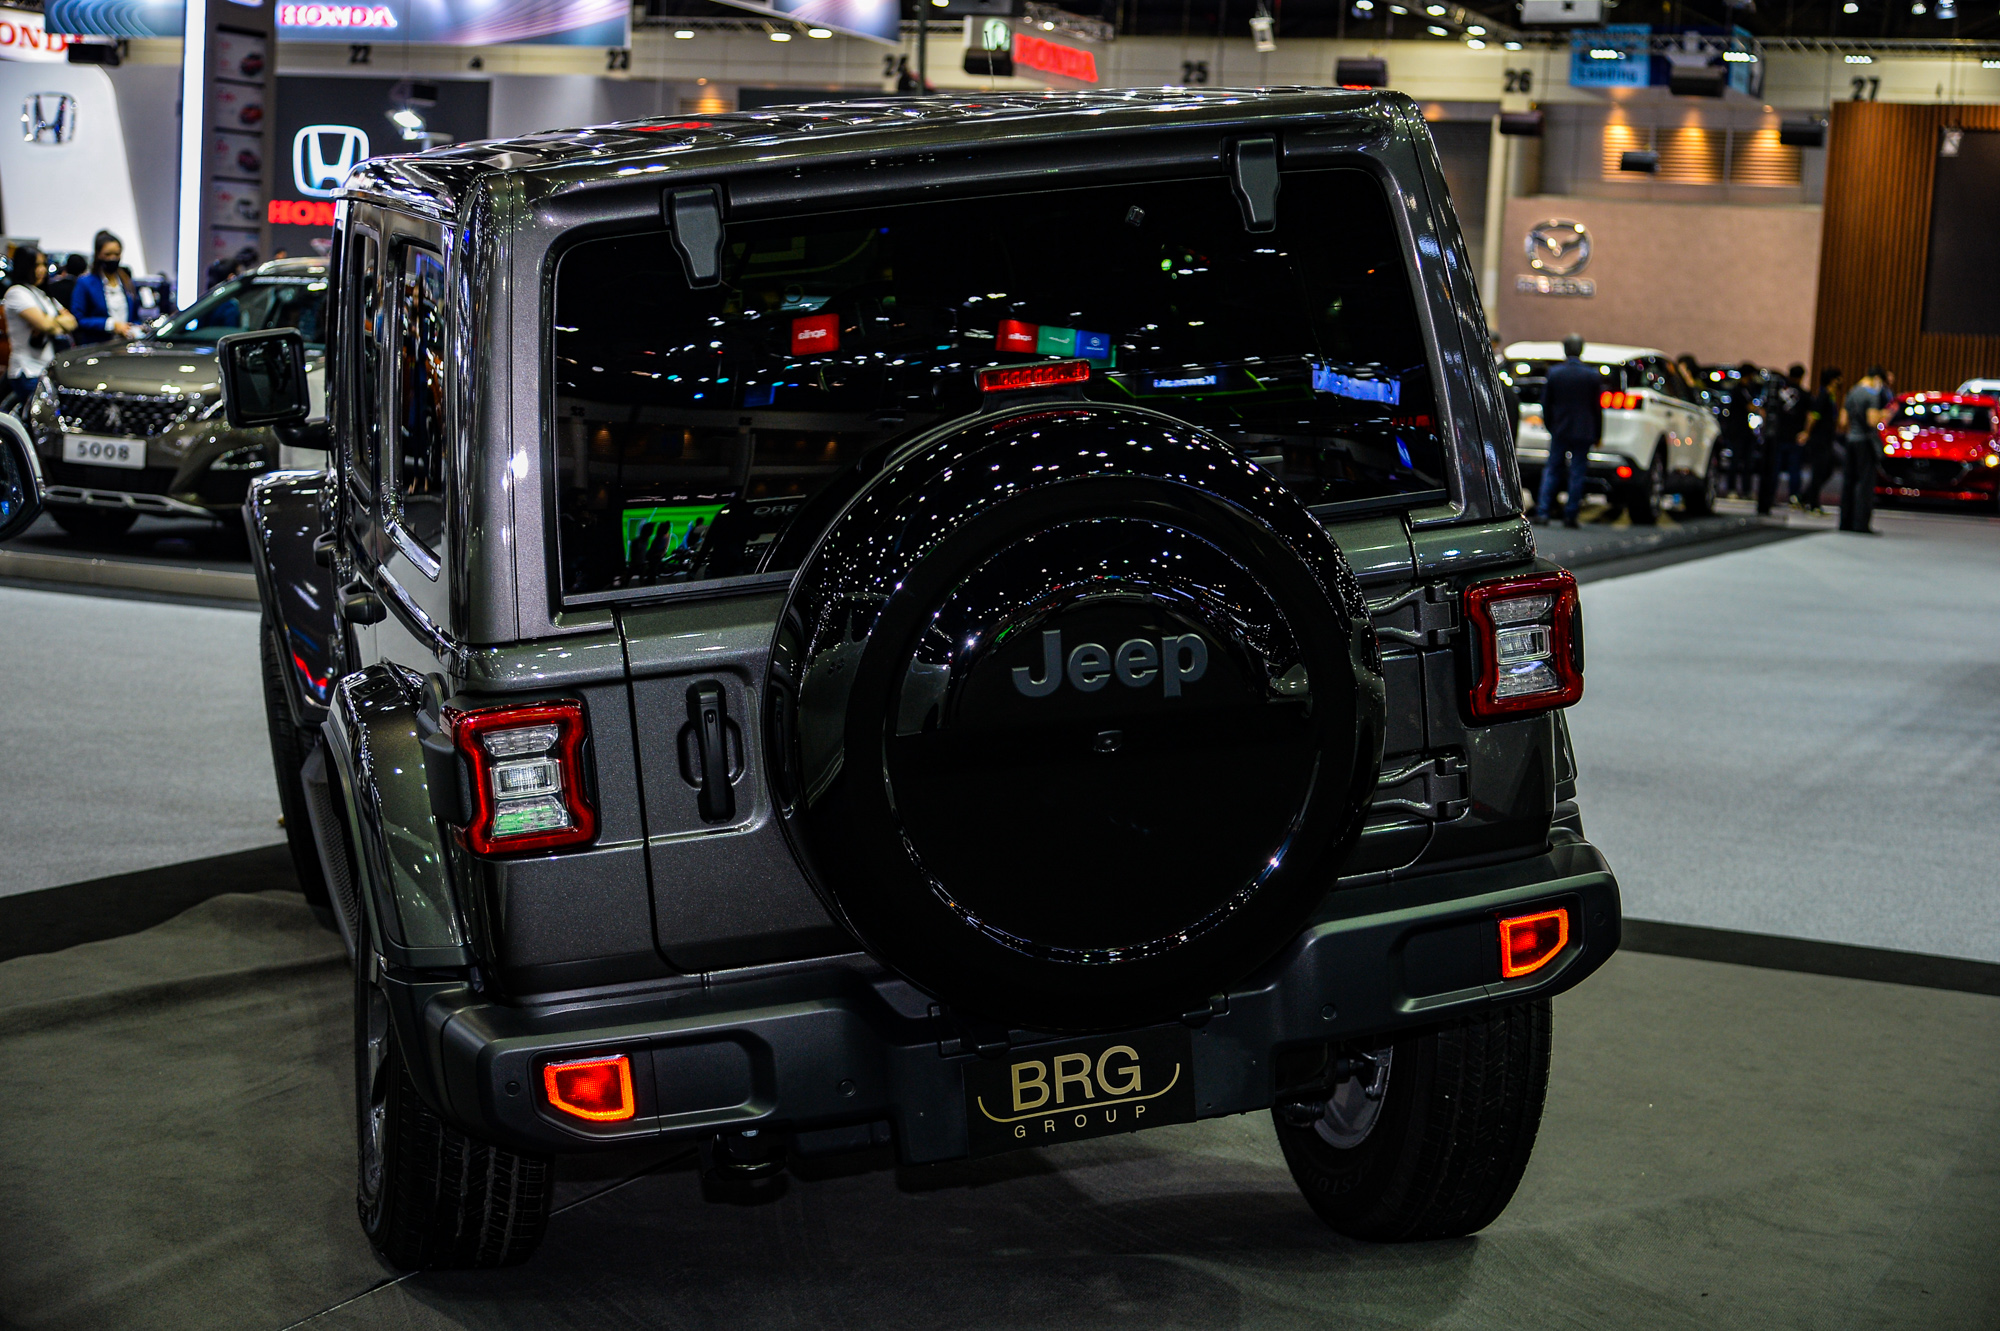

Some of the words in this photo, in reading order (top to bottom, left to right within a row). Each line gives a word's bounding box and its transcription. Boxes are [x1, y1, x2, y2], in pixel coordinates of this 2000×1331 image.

[279, 4, 397, 27] HONDA
[0, 22, 84, 52] OND
[349, 43, 371, 64] 22
[606, 47, 631, 71] 23
[1013, 32, 1098, 83] HONDA
[1182, 60, 1209, 83] 25
[1504, 68, 1533, 93] 26
[1851, 76, 1880, 101] 27
[77, 441, 130, 462] 5008
[1012, 629, 1208, 698] Jeep
[1011, 1045, 1142, 1112] BRG
[1014, 1105, 1146, 1138] GROUP
